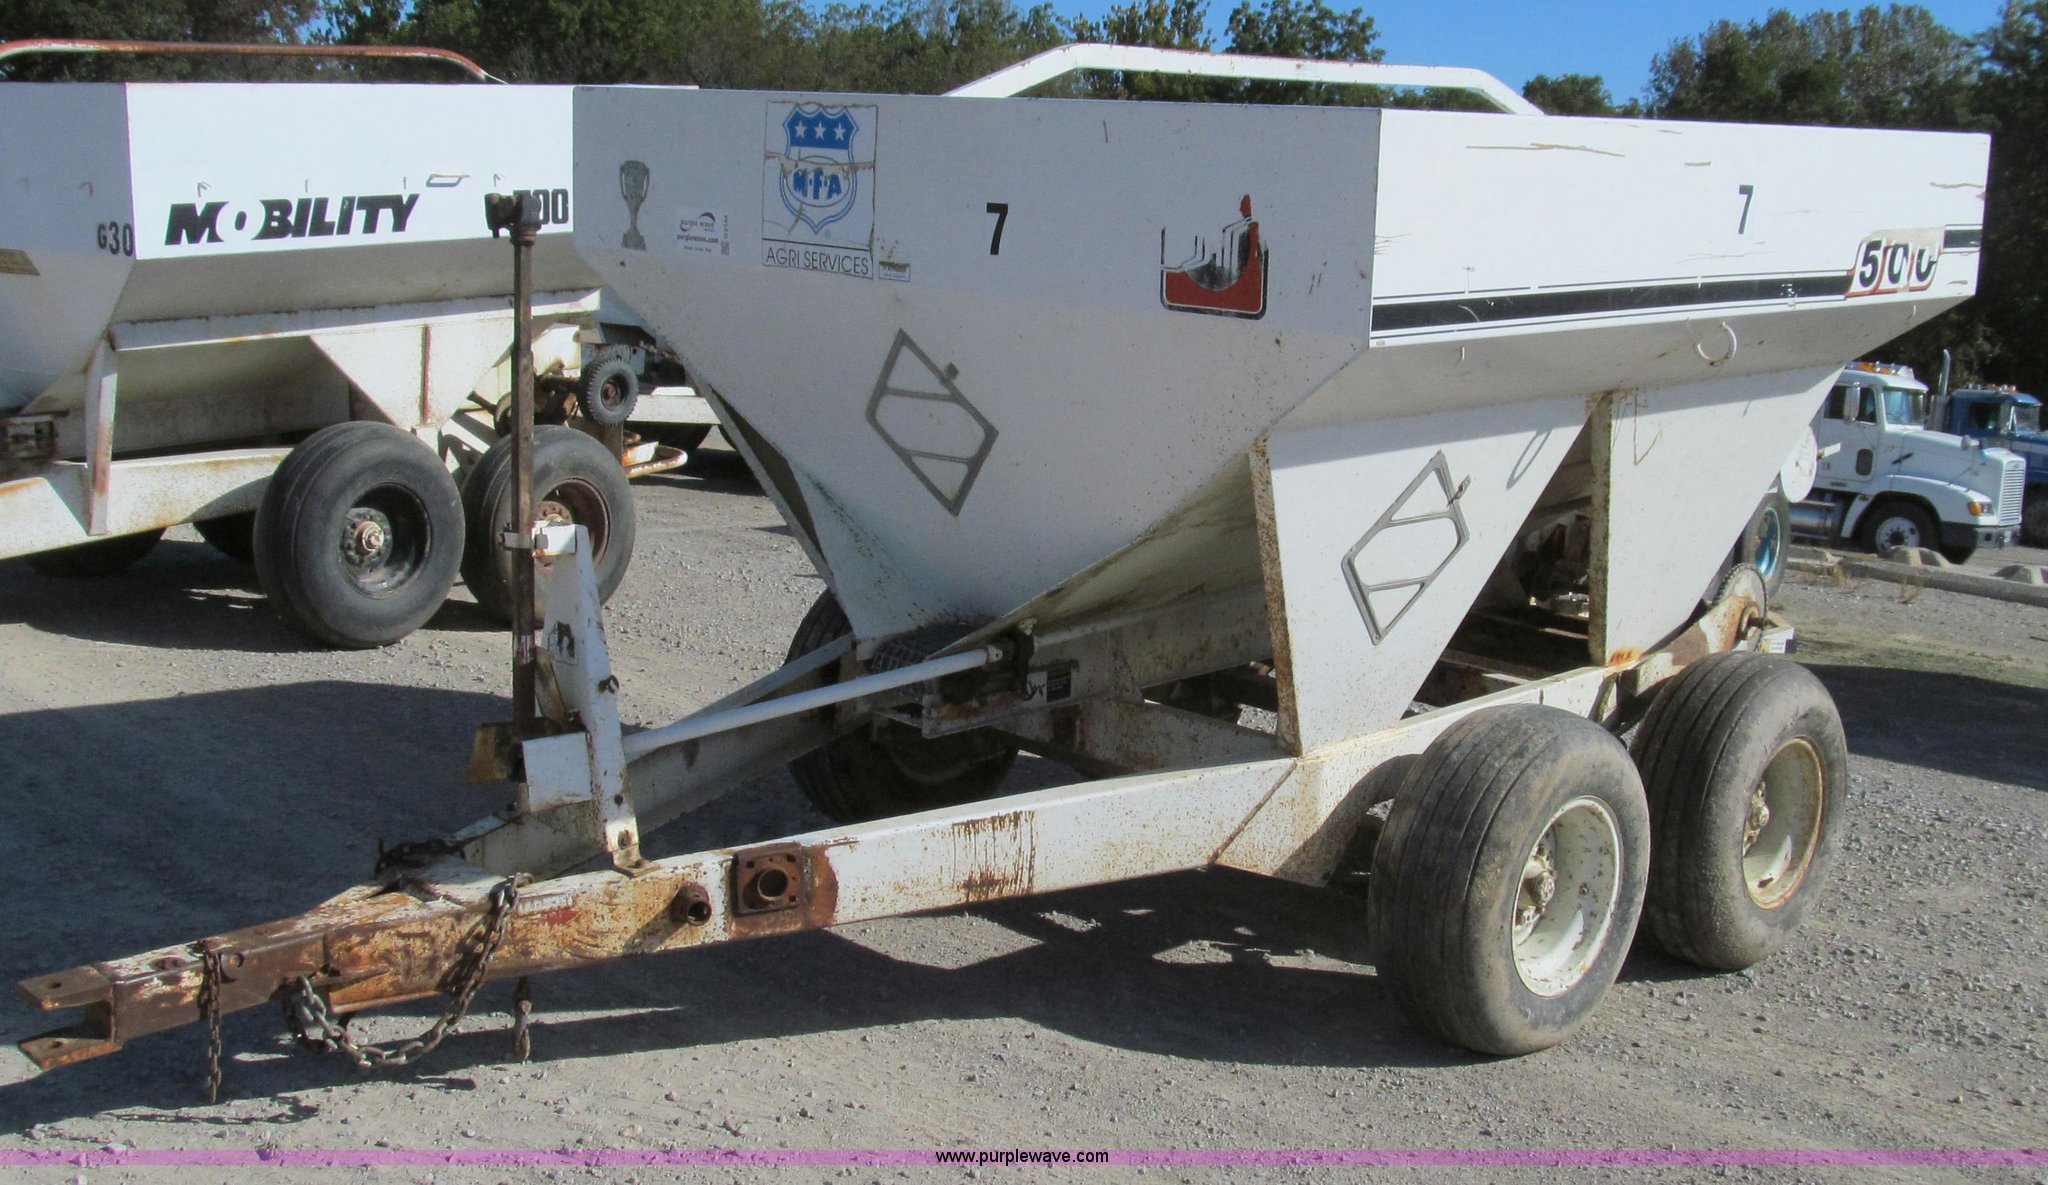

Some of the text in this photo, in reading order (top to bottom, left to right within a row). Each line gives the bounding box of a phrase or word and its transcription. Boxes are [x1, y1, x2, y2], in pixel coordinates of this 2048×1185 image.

[165, 194, 420, 245] MOBILITY
[513, 188, 569, 225] 00
[1738, 184, 1754, 234] 7
[97, 221, 133, 257] G30
[986, 202, 1009, 255] 7
[765, 246, 869, 275] AGRI SERVICES
